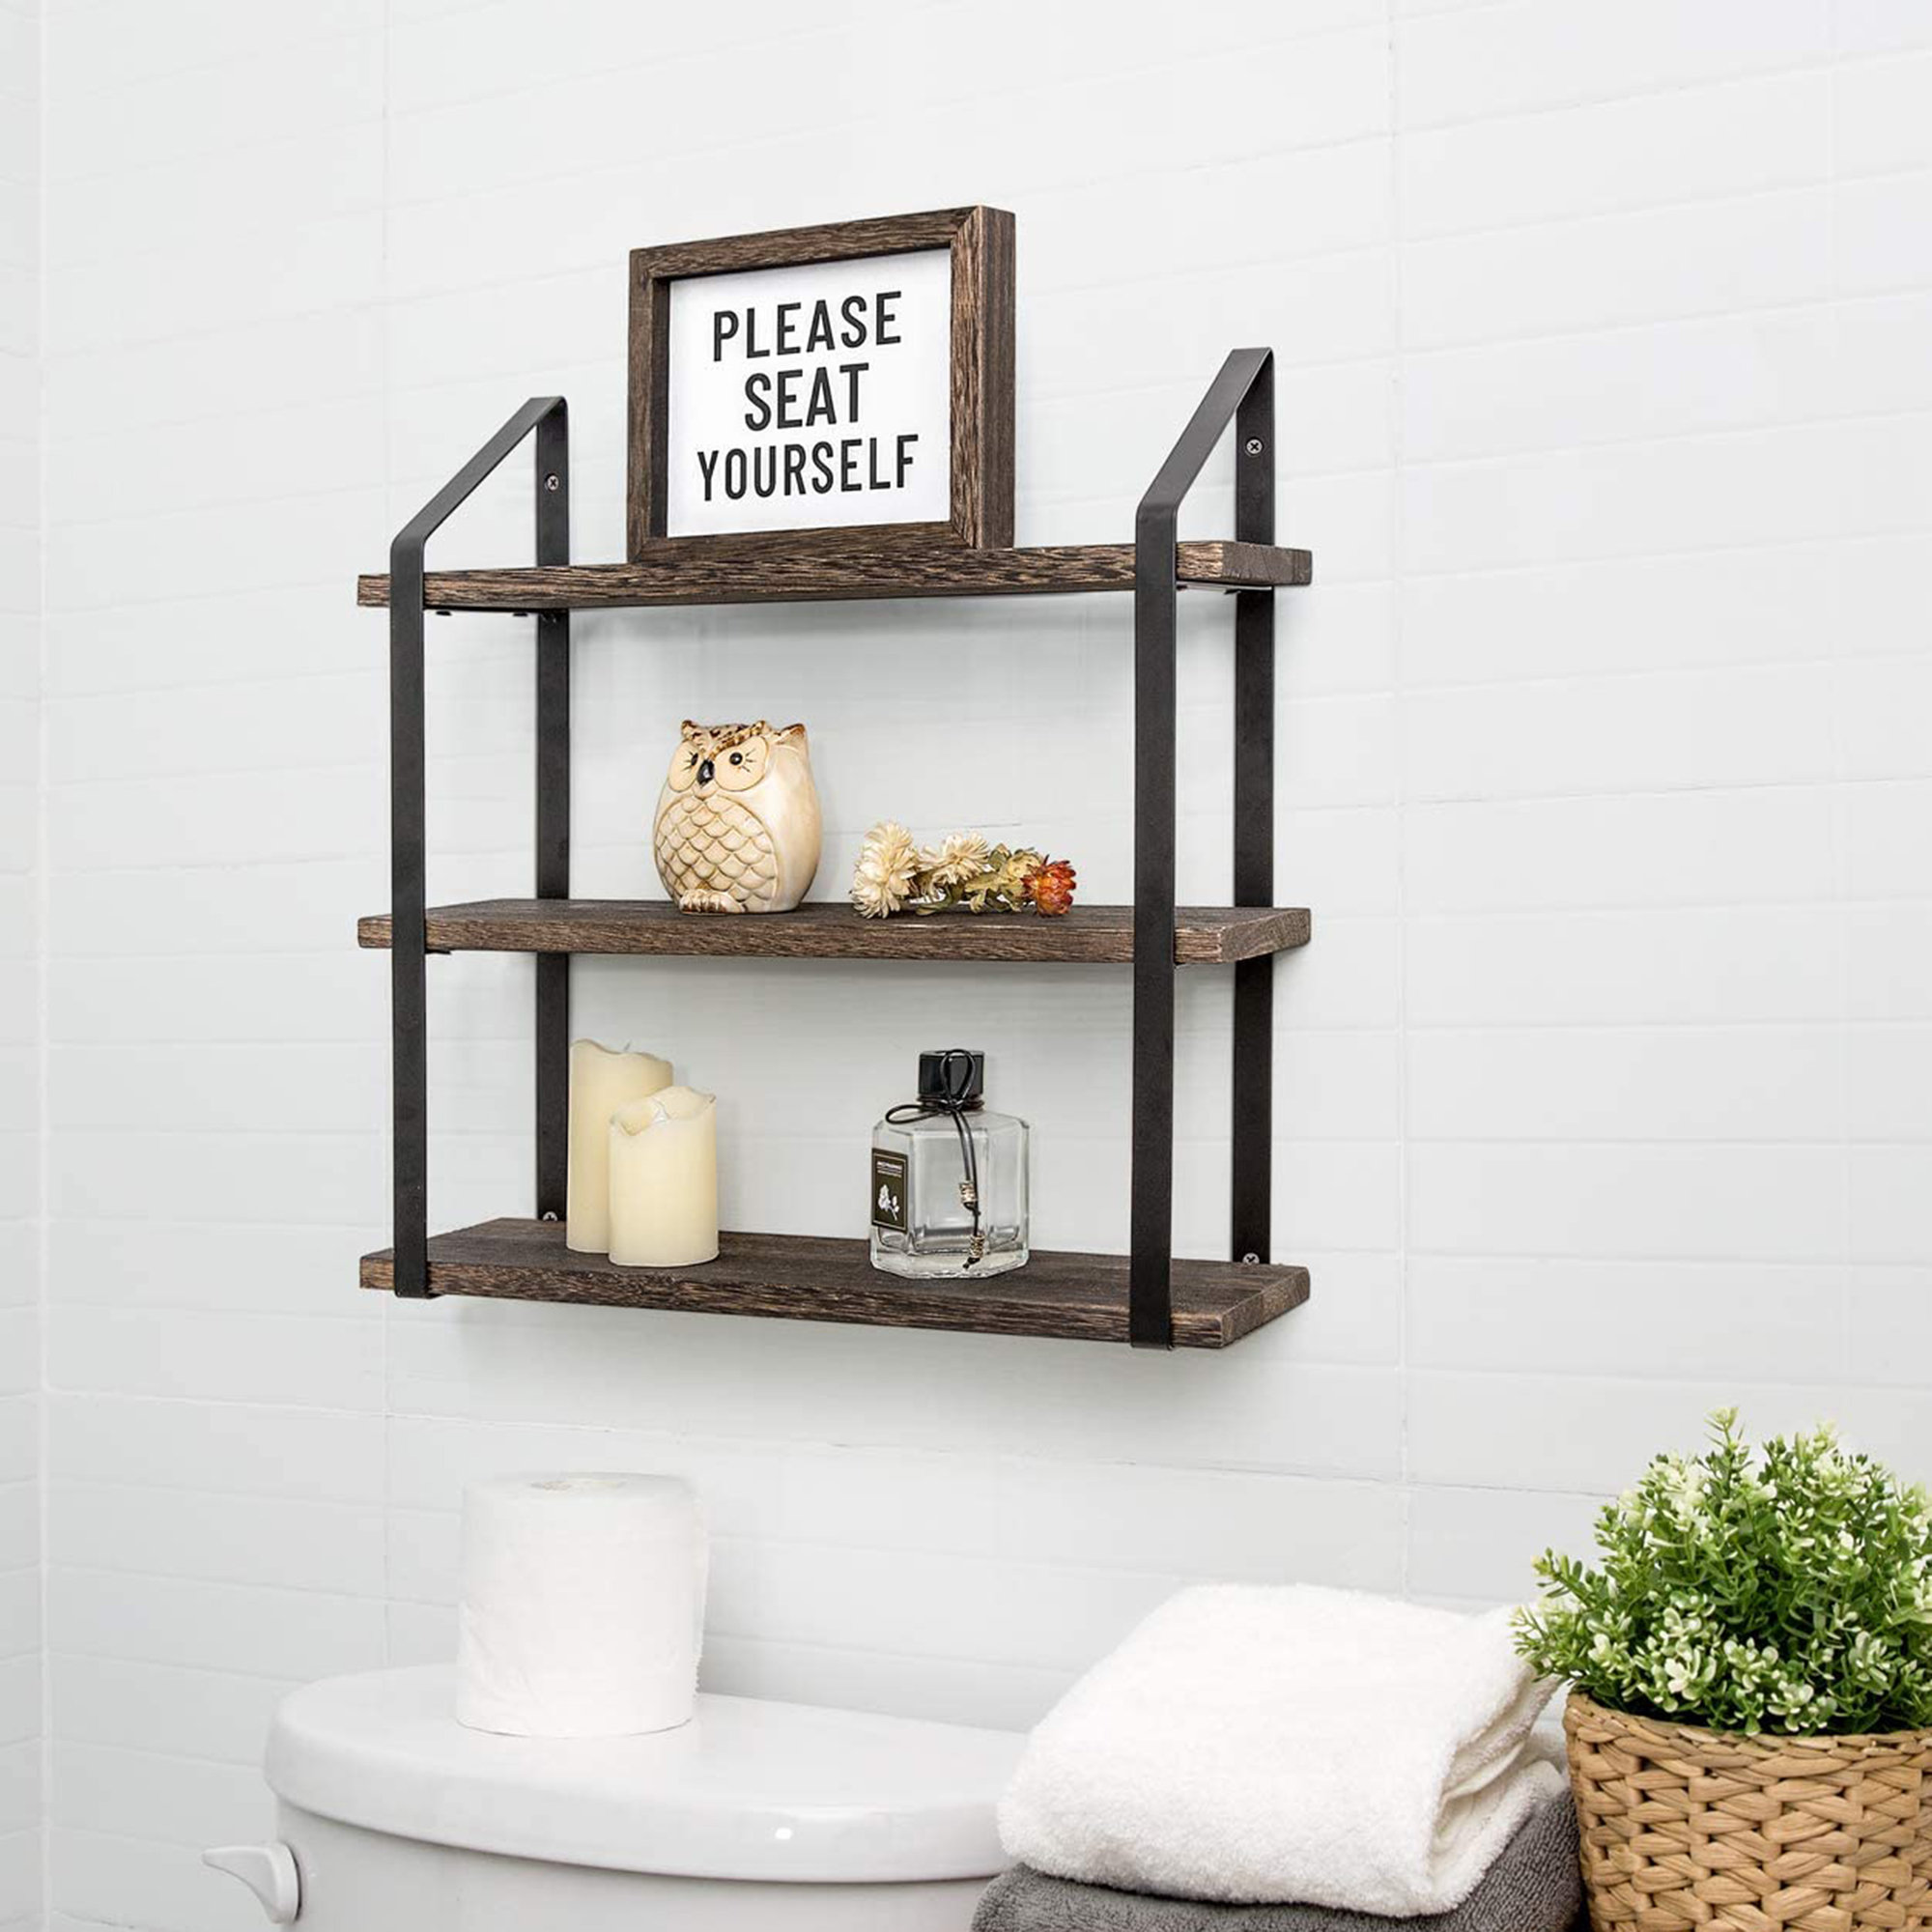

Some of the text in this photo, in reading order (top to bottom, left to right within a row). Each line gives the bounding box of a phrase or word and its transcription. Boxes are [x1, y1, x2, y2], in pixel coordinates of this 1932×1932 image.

[713, 291, 902, 362] PLEASE
[745, 362, 869, 432] SEAT
[696, 434, 919, 501] YOURSELF
